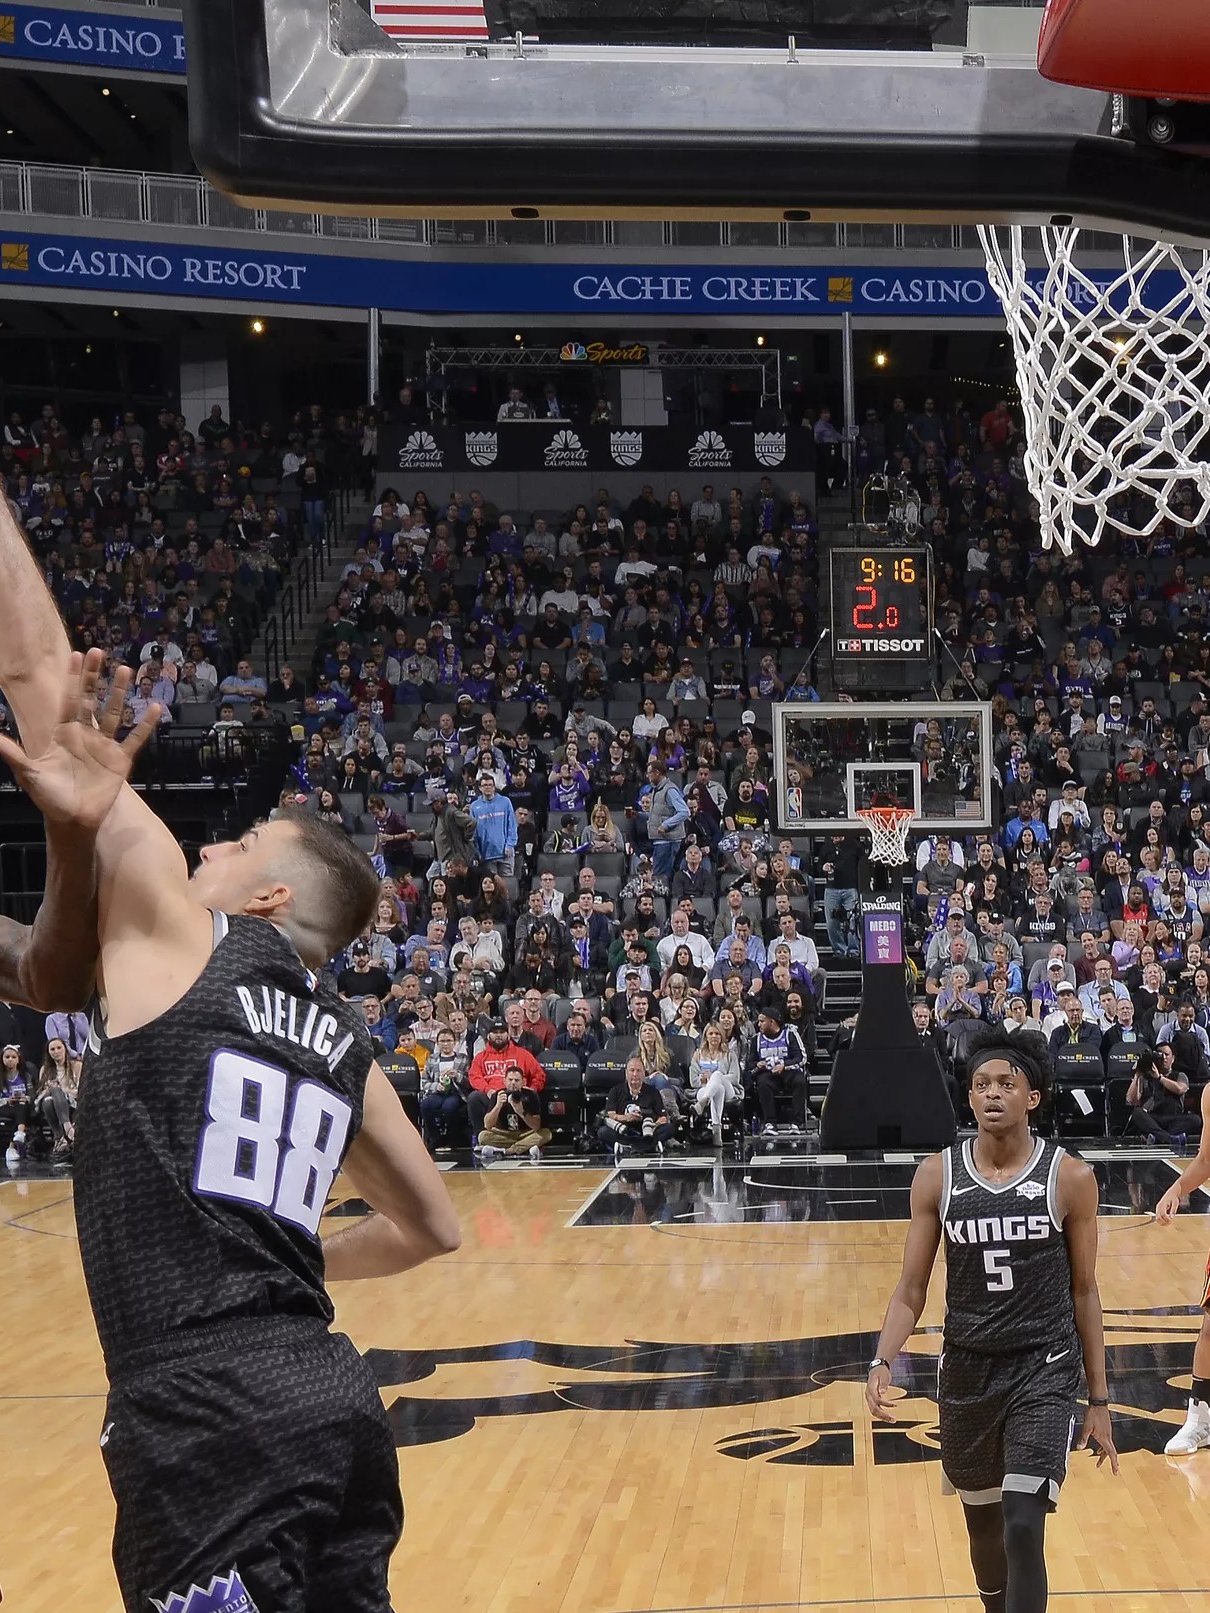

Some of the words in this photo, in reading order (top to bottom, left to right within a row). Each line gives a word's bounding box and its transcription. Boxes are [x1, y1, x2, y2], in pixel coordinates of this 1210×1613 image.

[24, 19, 162, 57] CASINO
[38, 247, 171, 282] CASINO
[183, 258, 307, 291] RESORT
[573, 276, 692, 301] CACHE
[702, 277, 820, 301] CREEK
[860, 278, 986, 303] CASINO
[586, 342, 646, 363] Sports
[398, 447, 444, 462] Sports
[466, 445, 497, 453] KINGS
[543, 447, 589, 461] Sports
[611, 445, 642, 453] KINGS
[688, 447, 733, 461] Sports
[755, 445, 786, 453] KINGS
[862, 639, 924, 651] TISSOT
[862, 901, 901, 911] SPALDING
[236, 986, 355, 1072] BJELICA
[193, 1047, 352, 1239] 88
[946, 1215, 1050, 1244] KINGS
[983, 1250, 1013, 1291] 5
